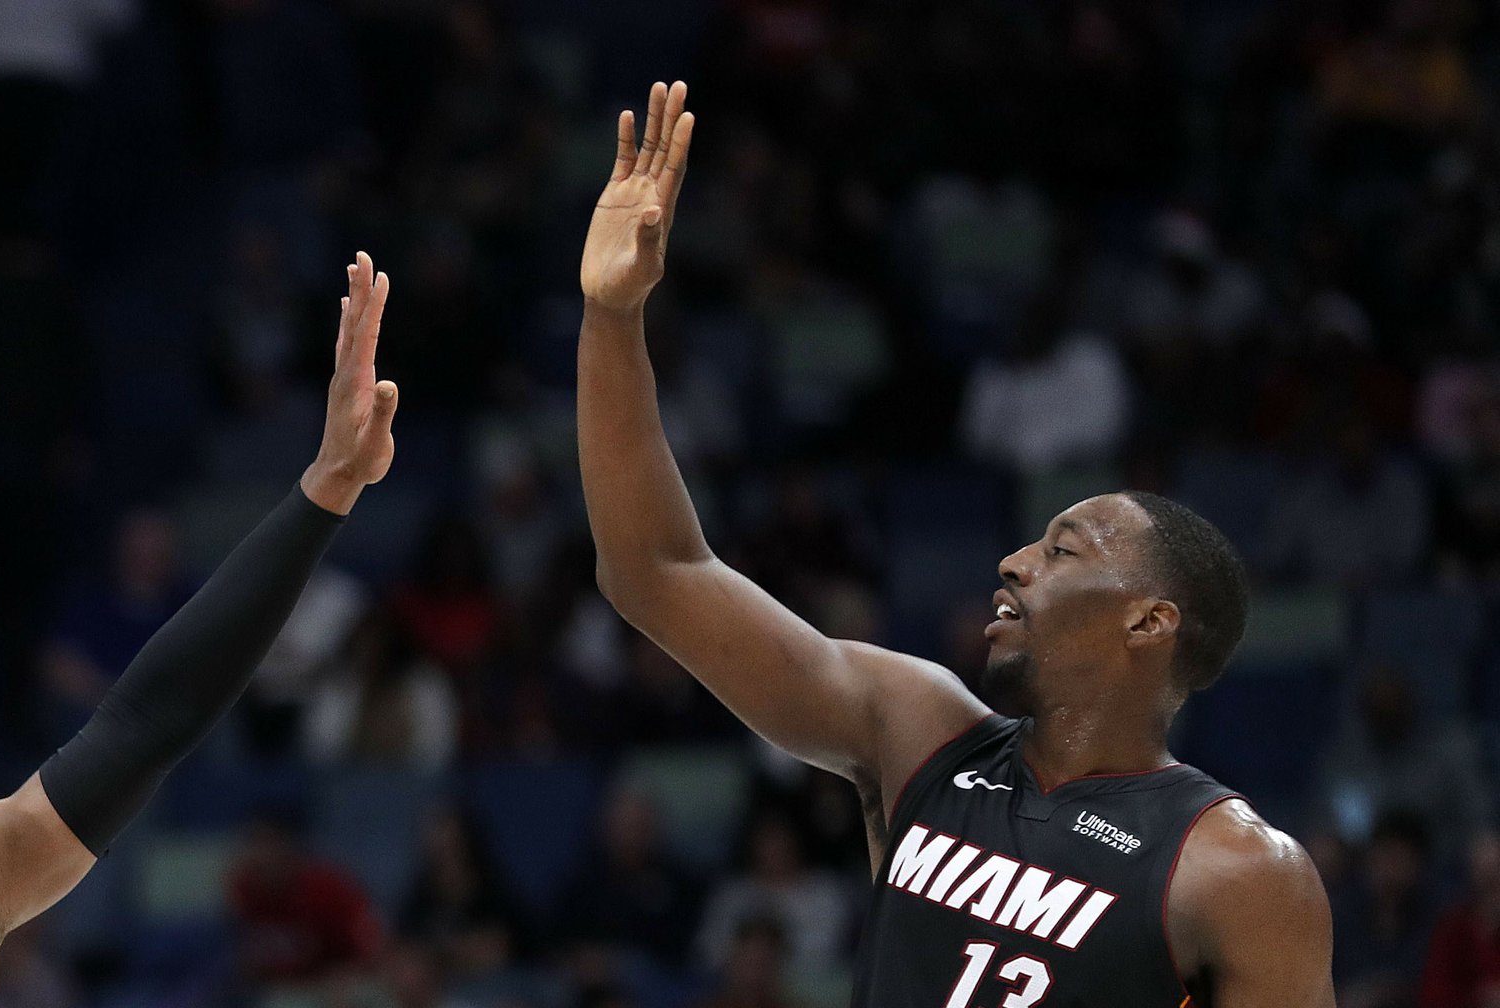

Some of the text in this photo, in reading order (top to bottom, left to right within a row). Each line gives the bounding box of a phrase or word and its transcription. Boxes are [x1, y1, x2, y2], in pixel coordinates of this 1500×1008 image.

[1072, 824, 1133, 855] SOFTWARE
[1076, 810, 1142, 849] Ultimate
[887, 821, 1119, 951] MIAMI
